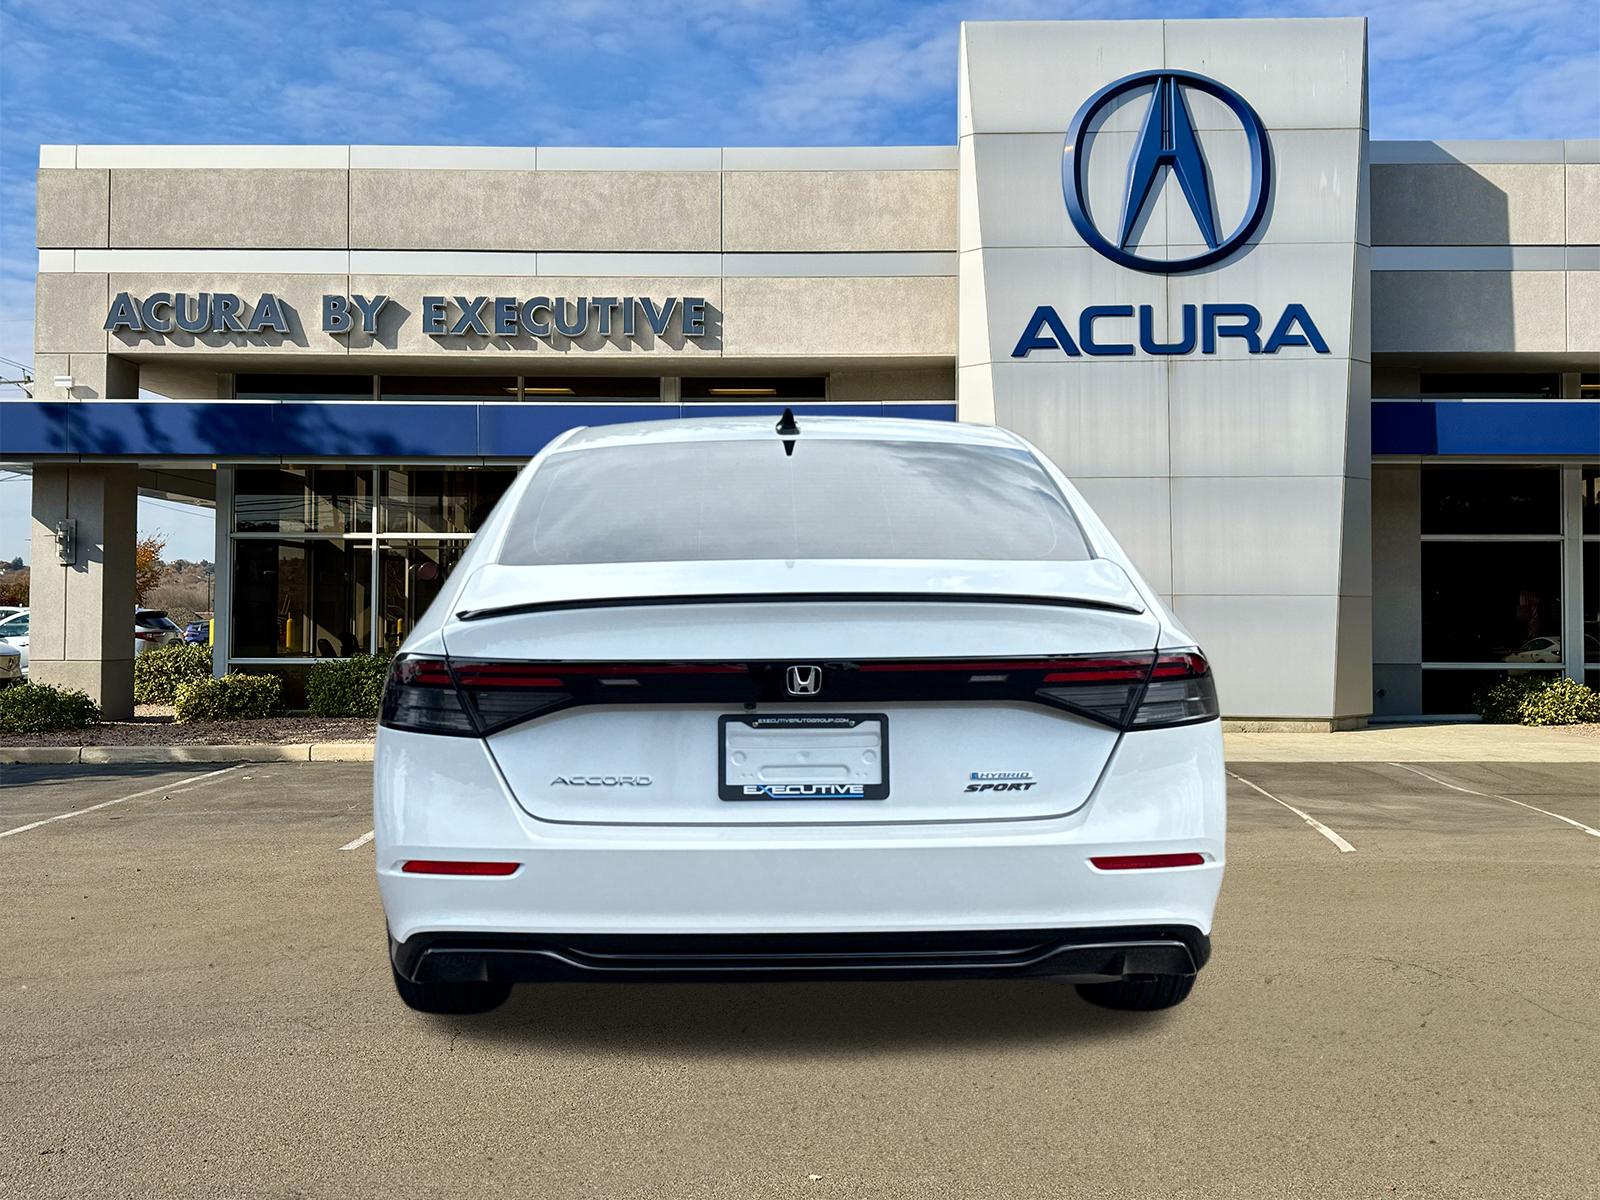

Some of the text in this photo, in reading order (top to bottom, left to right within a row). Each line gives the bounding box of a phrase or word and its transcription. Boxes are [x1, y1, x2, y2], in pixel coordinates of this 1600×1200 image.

[104, 292, 708, 338] ACURA BY EXECUTIVE
[1011, 303, 1331, 357] ACURA
[550, 776, 653, 786] ACCORD
[963, 782, 1037, 792] SPORT
[743, 784, 864, 797] EXECUTIVE
